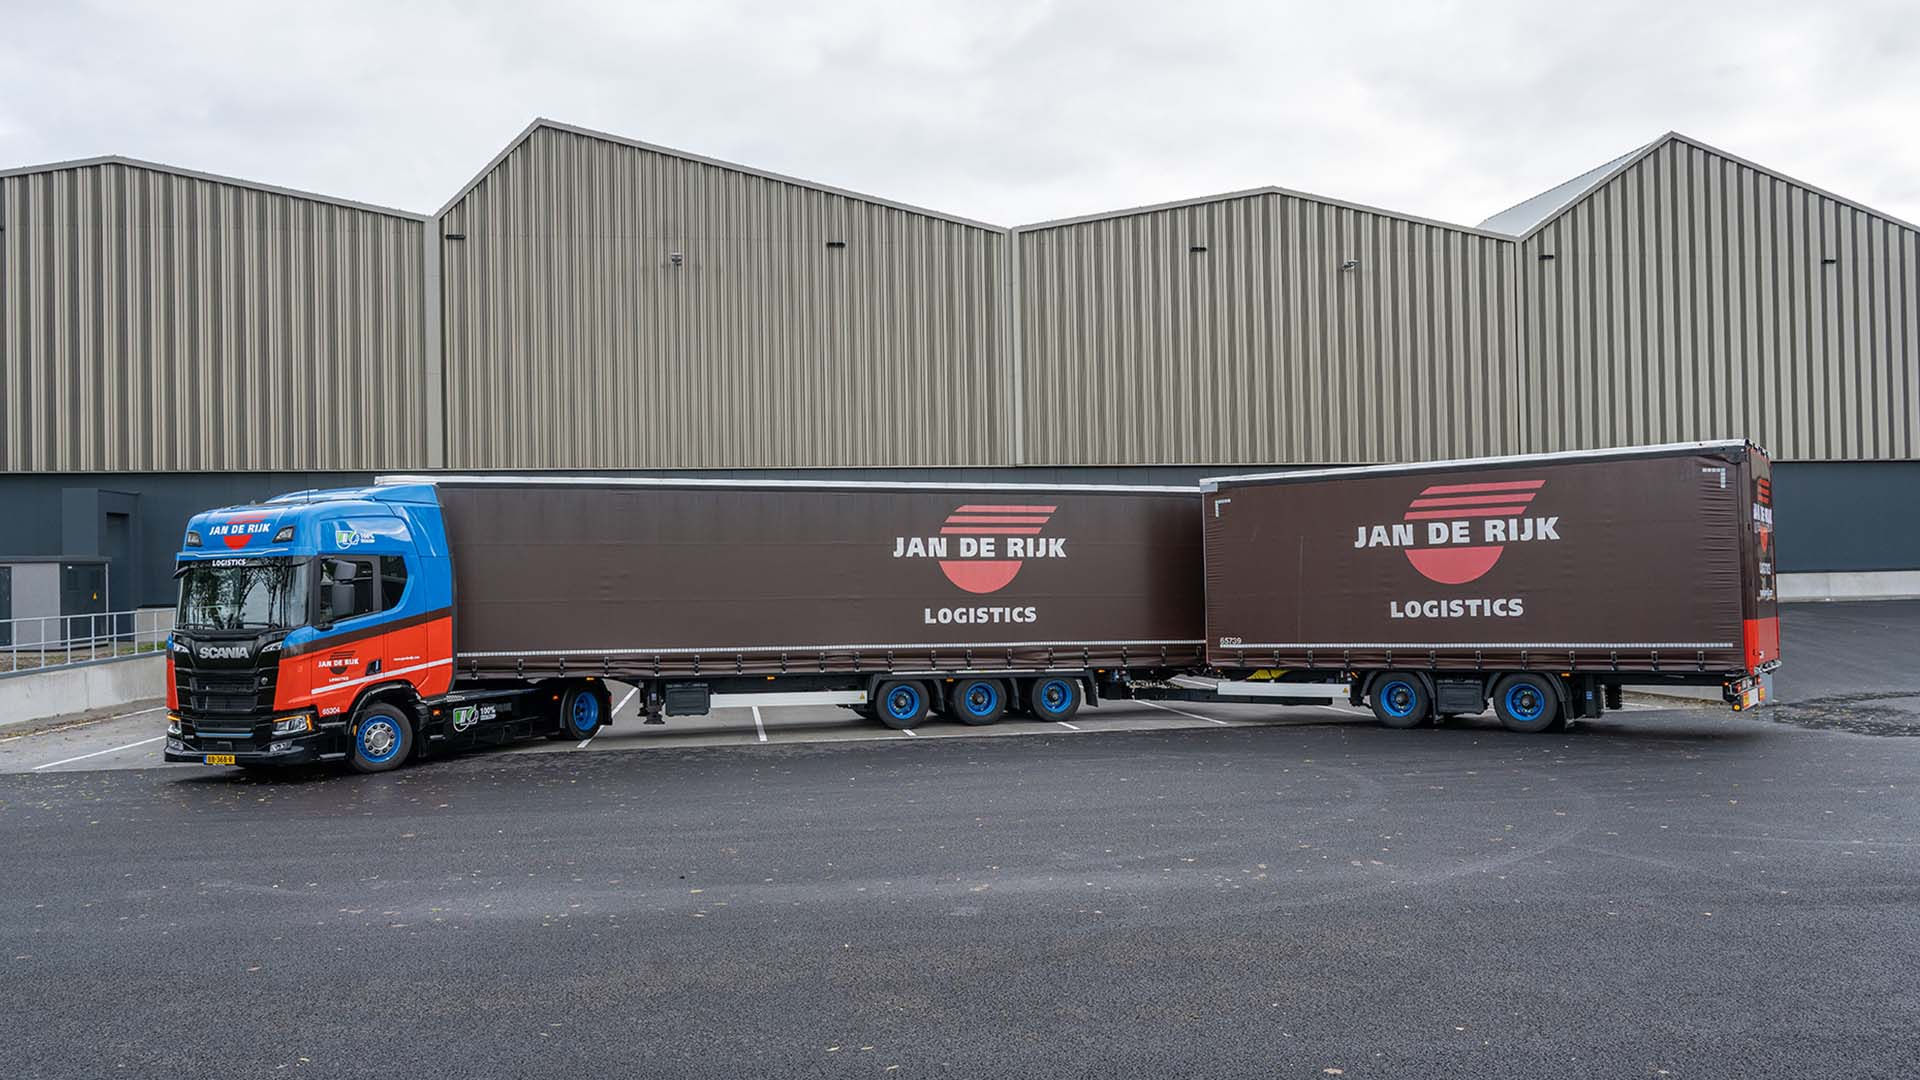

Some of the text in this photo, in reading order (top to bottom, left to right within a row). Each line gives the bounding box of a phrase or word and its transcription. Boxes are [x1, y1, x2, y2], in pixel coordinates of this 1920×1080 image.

[209, 523, 271, 536] JAN DE RIJK
[1354, 517, 1560, 548] JAN DE RIJK
[893, 537, 1067, 558] JAN DE RIJK
[212, 559, 246, 567] LOGISTICS
[924, 607, 1037, 624] LOGISTICS
[1390, 598, 1524, 618] LOGISTICS
[199, 647, 249, 659] SCANIA
[318, 660, 333, 668] JAN
[333, 659, 344, 667] DE
